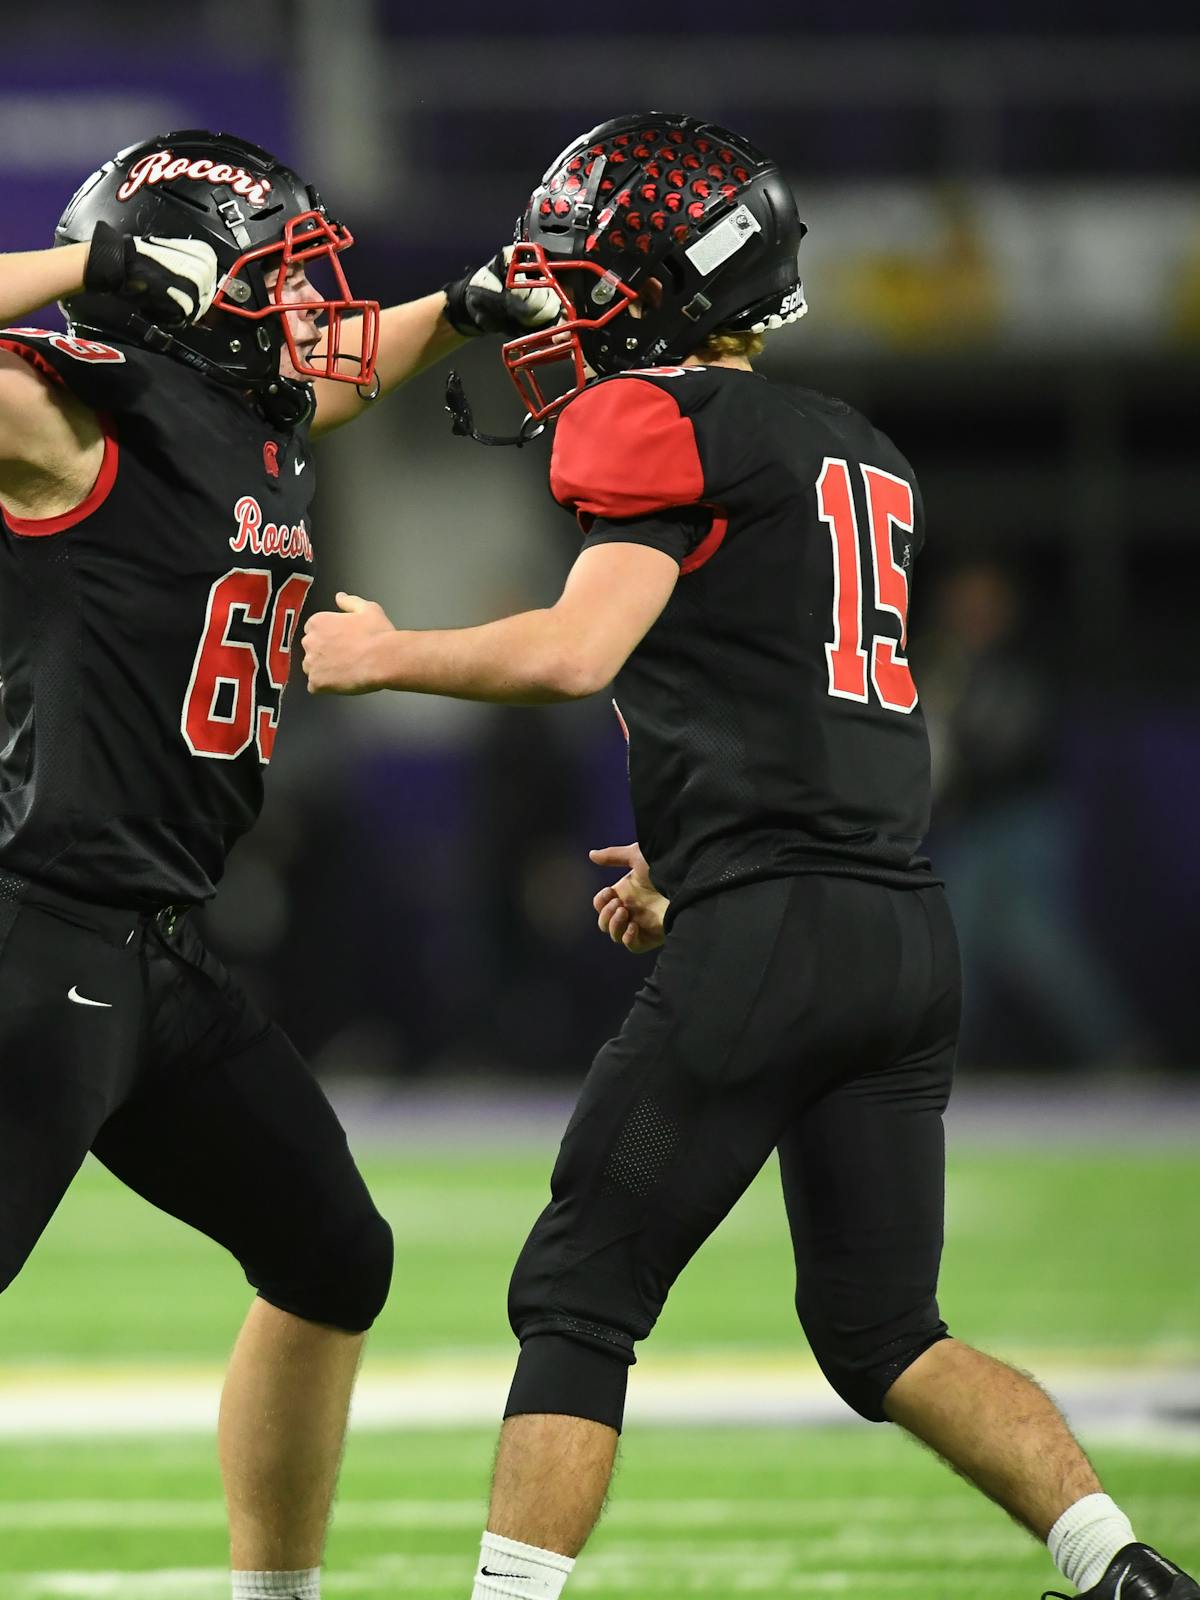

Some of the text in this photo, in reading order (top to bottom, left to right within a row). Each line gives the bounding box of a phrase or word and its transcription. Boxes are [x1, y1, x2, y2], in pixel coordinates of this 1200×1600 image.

[116, 148, 273, 207] Rocori
[181, 567, 314, 764] 69
[815, 457, 919, 714] 15
